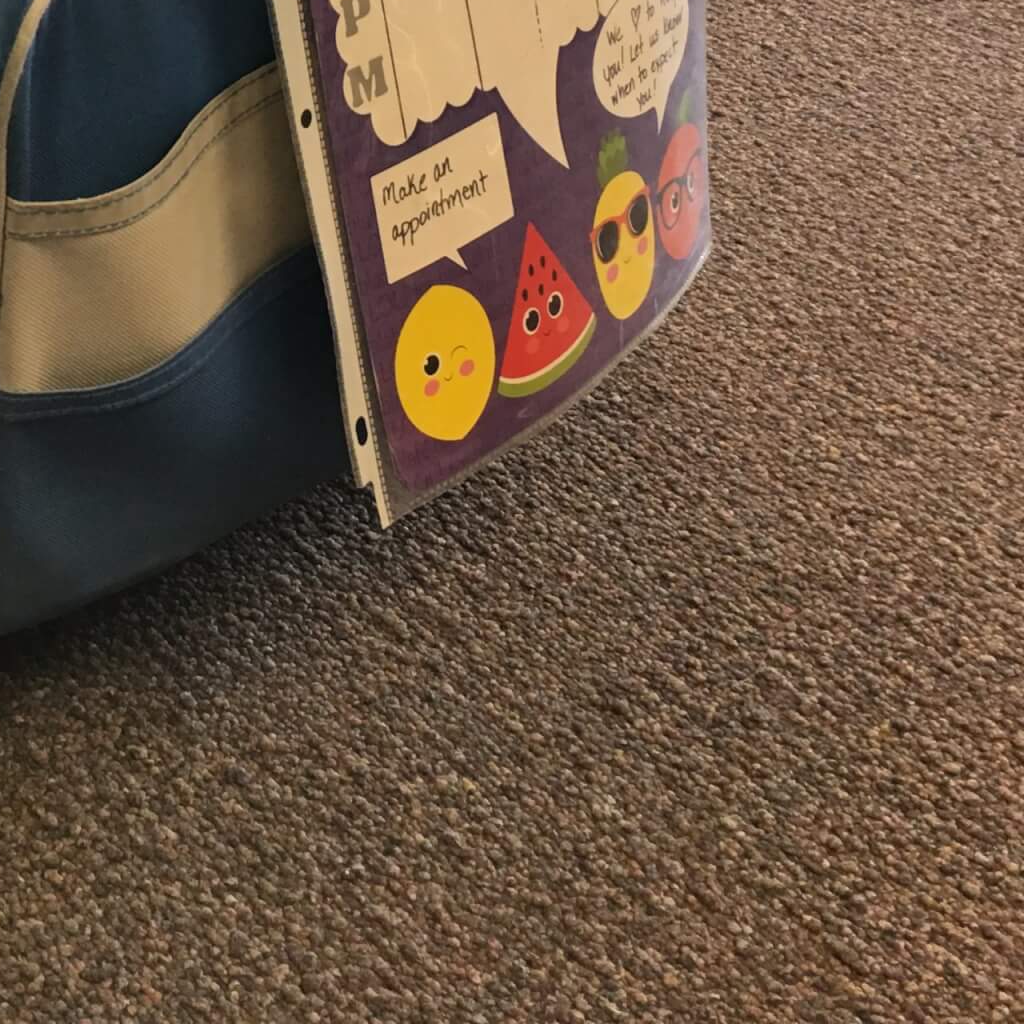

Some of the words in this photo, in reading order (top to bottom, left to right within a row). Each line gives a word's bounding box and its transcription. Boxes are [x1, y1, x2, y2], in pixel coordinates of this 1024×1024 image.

[381, 173, 428, 207] Make
[433, 156, 453, 181] an
[392, 171, 488, 247] appointment
